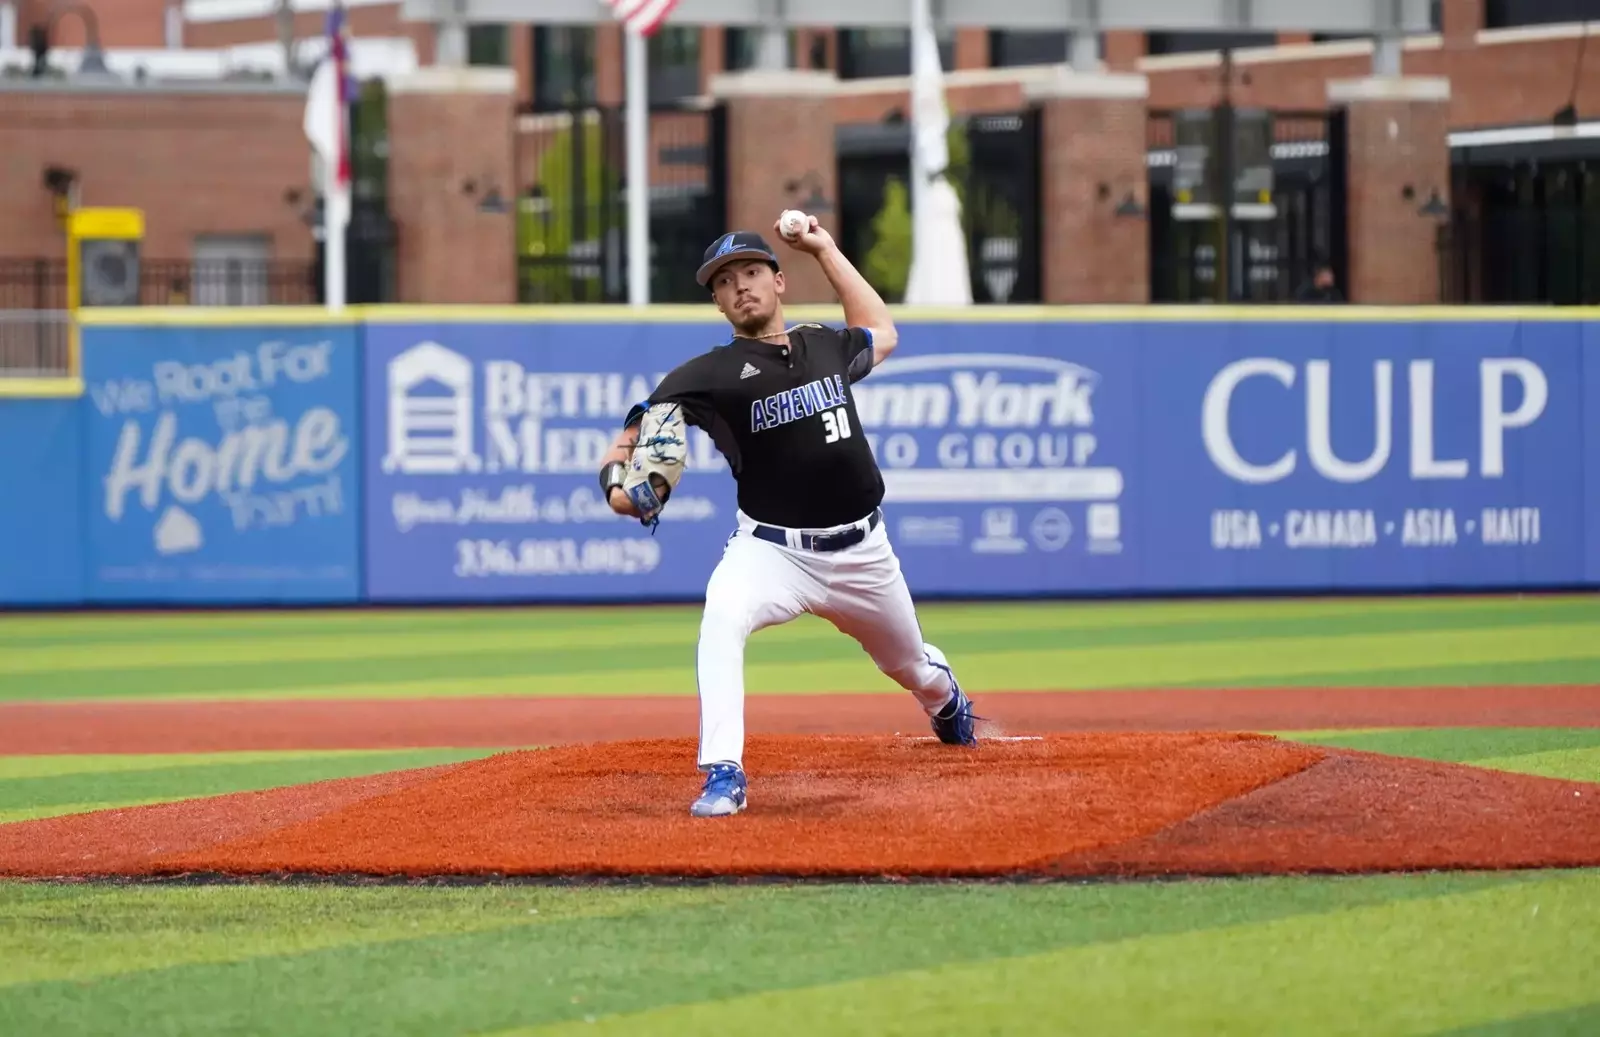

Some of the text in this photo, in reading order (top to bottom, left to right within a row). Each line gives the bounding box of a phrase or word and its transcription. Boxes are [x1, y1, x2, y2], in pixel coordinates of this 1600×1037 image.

[153, 350, 257, 404] Root
[257, 340, 334, 388] For
[487, 360, 667, 418] BETHA
[751, 374, 848, 433] ASHEVILLE
[821, 407, 851, 444] 30
[1201, 357, 1548, 484] CULP
[104, 405, 349, 522] Home
[937, 431, 1097, 468] GROUP
[1211, 506, 1541, 548] USA CANADA ASIA HAITI
